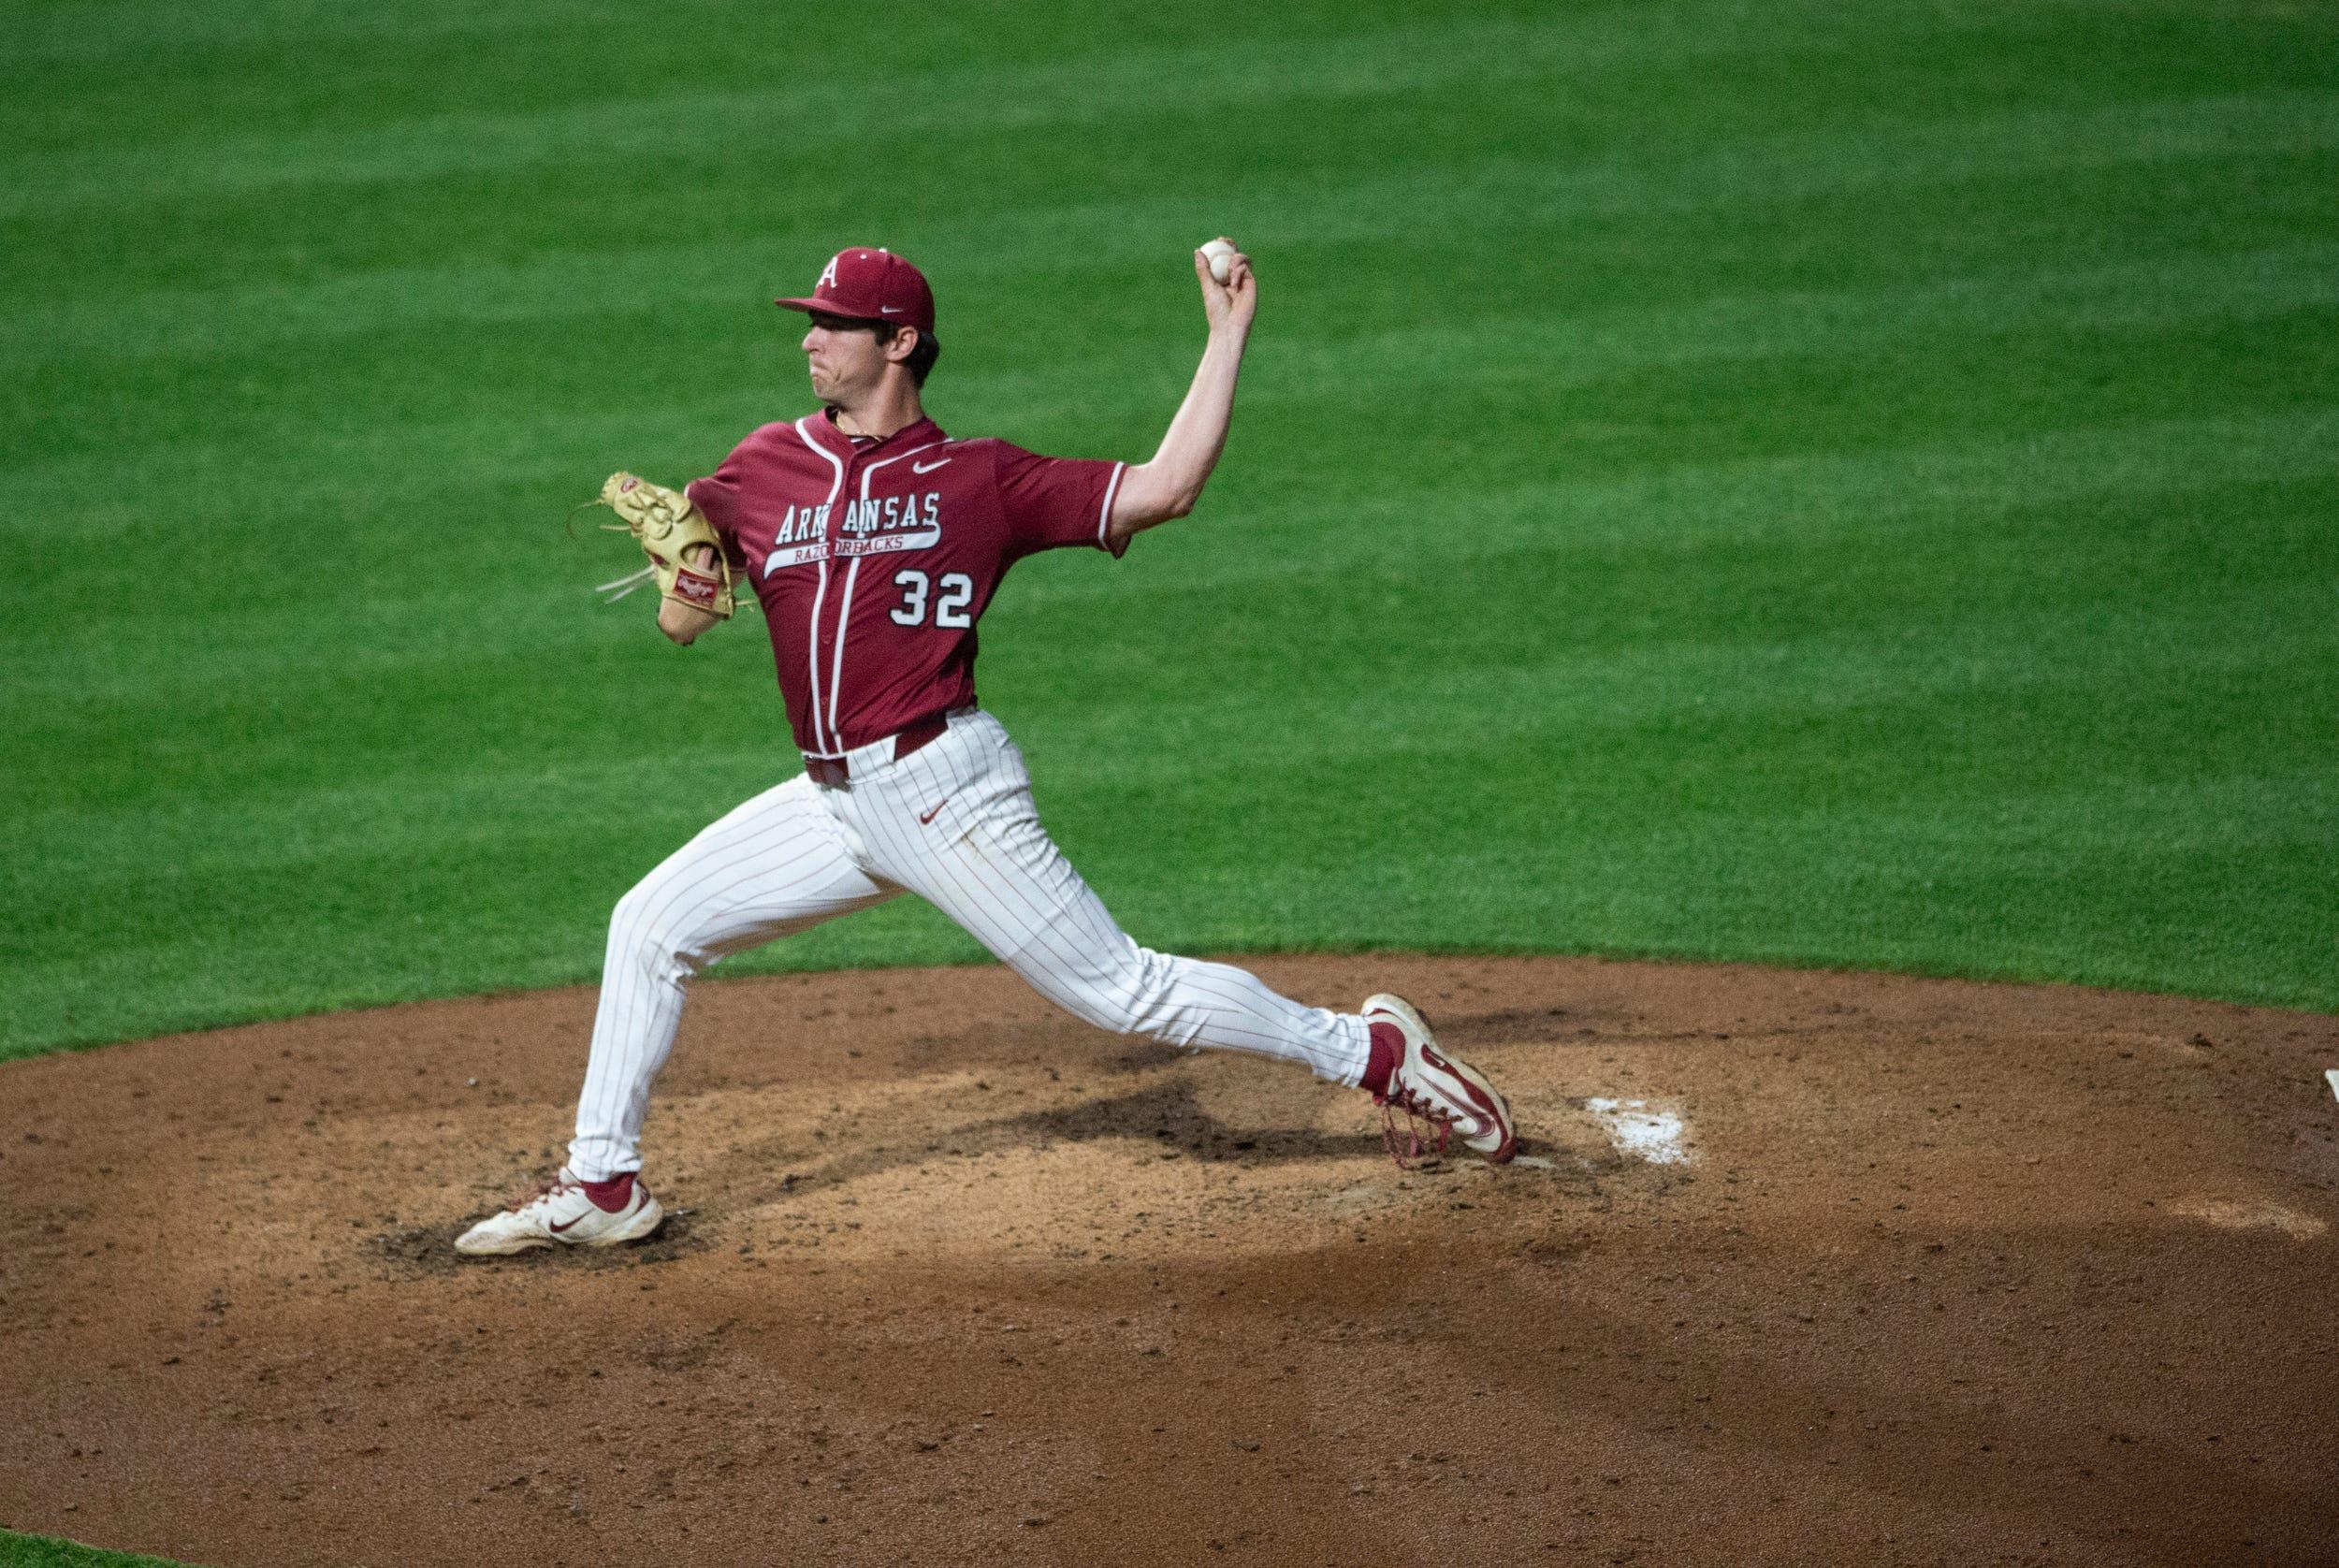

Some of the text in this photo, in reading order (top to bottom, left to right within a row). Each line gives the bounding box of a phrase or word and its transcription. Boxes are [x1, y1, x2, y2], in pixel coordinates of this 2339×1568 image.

[816, 255, 838, 288] A
[775, 492, 939, 545] ARKANSAS
[795, 536, 904, 562] RAZORBACKS
[890, 569, 972, 628] 32
